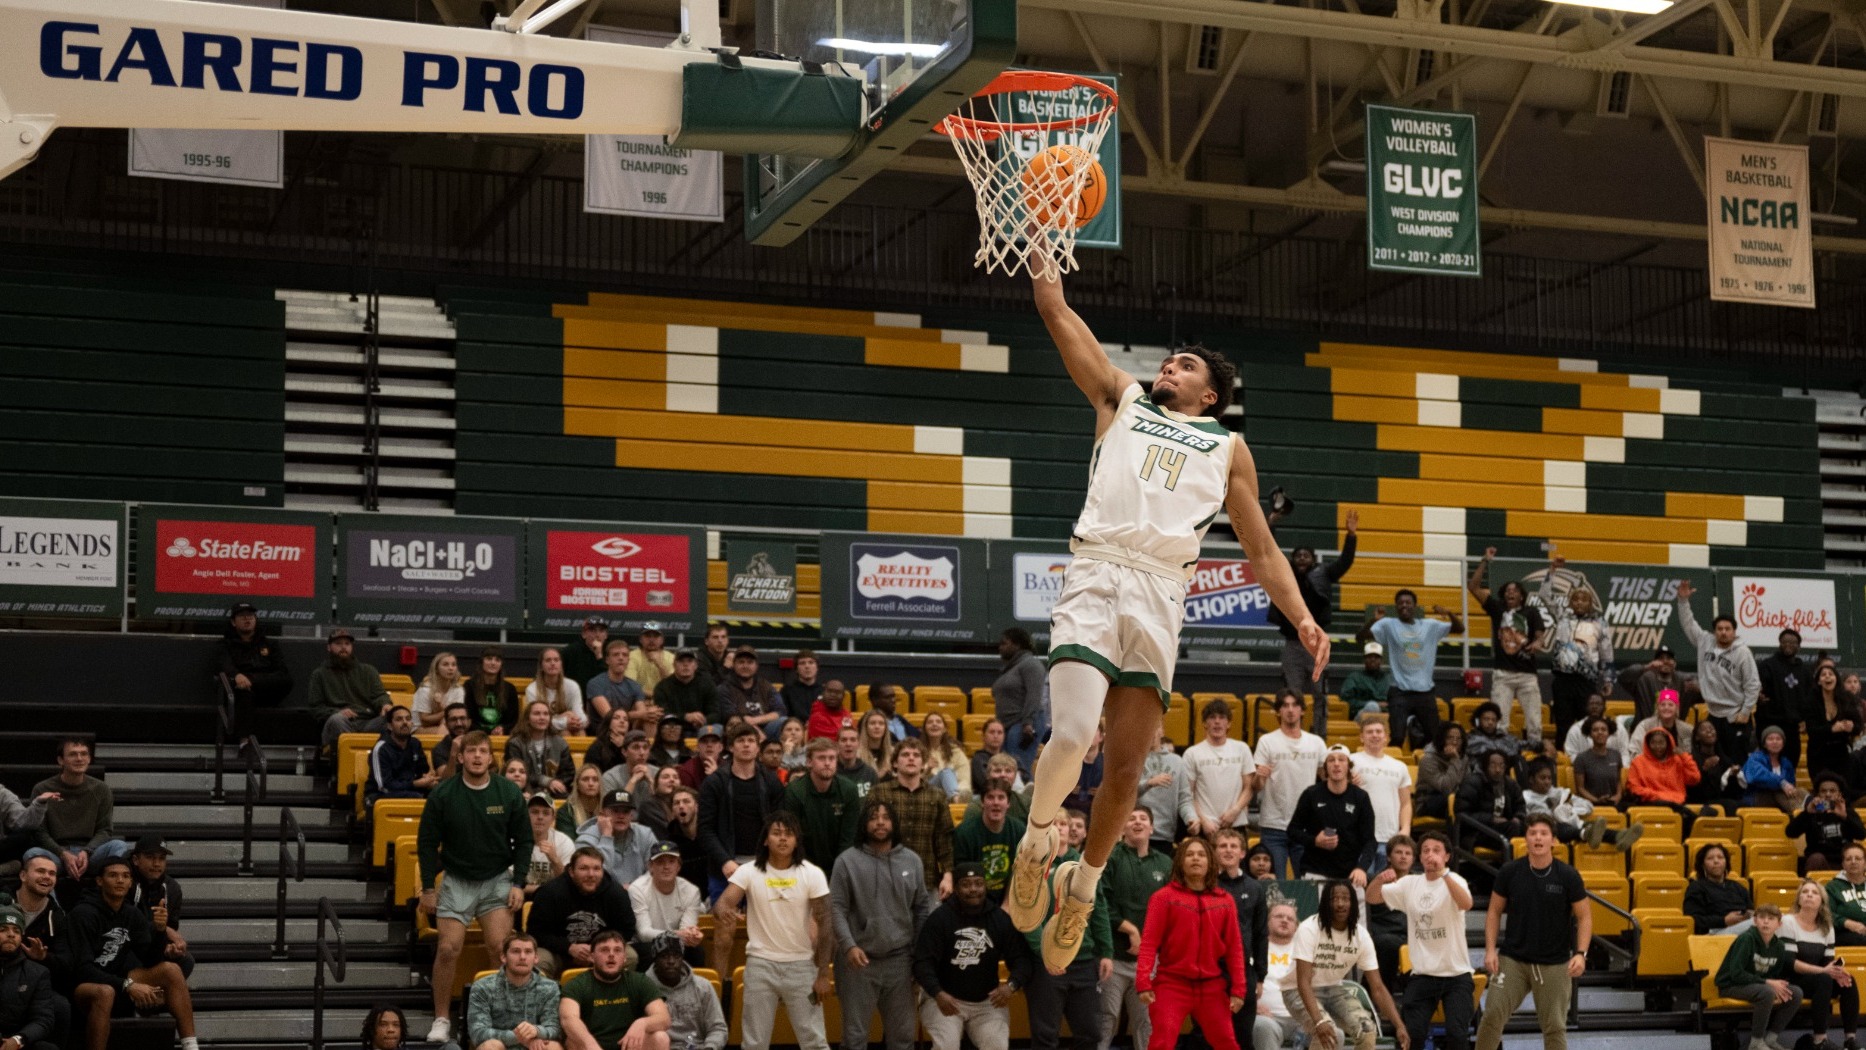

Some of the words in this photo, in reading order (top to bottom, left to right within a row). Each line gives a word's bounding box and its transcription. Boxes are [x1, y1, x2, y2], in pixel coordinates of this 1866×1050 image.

[40, 21, 363, 101] GARED
[400, 51, 585, 120] PRO
[1391, 118, 1452, 137] WOMEN'S
[616, 140, 693, 159] TOURNAMENT
[1386, 136, 1457, 156] VOLLEYBALL
[183, 153, 231, 168] 1995-96
[620, 159, 688, 176] CHAMPIONS
[1741, 154, 1777, 169] MEN'S
[1383, 162, 1463, 198] GLVC
[1726, 170, 1793, 189] BASKETBALL
[642, 191, 667, 204] 1996
[1391, 206, 1415, 220] WEST
[1417, 208, 1459, 223] DIVISION
[1720, 195, 1799, 229] NCAA
[1398, 222, 1453, 238] CHAMPIONS
[1741, 239, 1784, 252] NATIONAL
[1375, 247, 1398, 260] 2011
[1407, 250, 1430, 263] 2012
[1734, 253, 1793, 268] TOURNAMENT
[1135, 419, 1216, 452] MINERS
[1139, 444, 1188, 492] 14
[0, 526, 111, 557] LEGENDS
[560, 565, 676, 583] BIOSTEEL
[877, 564, 933, 576] REALTY
[1184, 563, 1246, 593] PRICE
[734, 577, 787, 588] PICKAXE
[862, 574, 948, 590] EXECUTIVES
[1609, 577, 1656, 599] THIS
[1658, 578, 1681, 601] IS
[737, 588, 789, 600] PLATOON
[866, 600, 895, 611] Ferrell
[897, 602, 946, 613] Associates
[1604, 601, 1673, 626] MINER
[1610, 626, 1665, 650] TION
[1270, 953, 1289, 966] M
